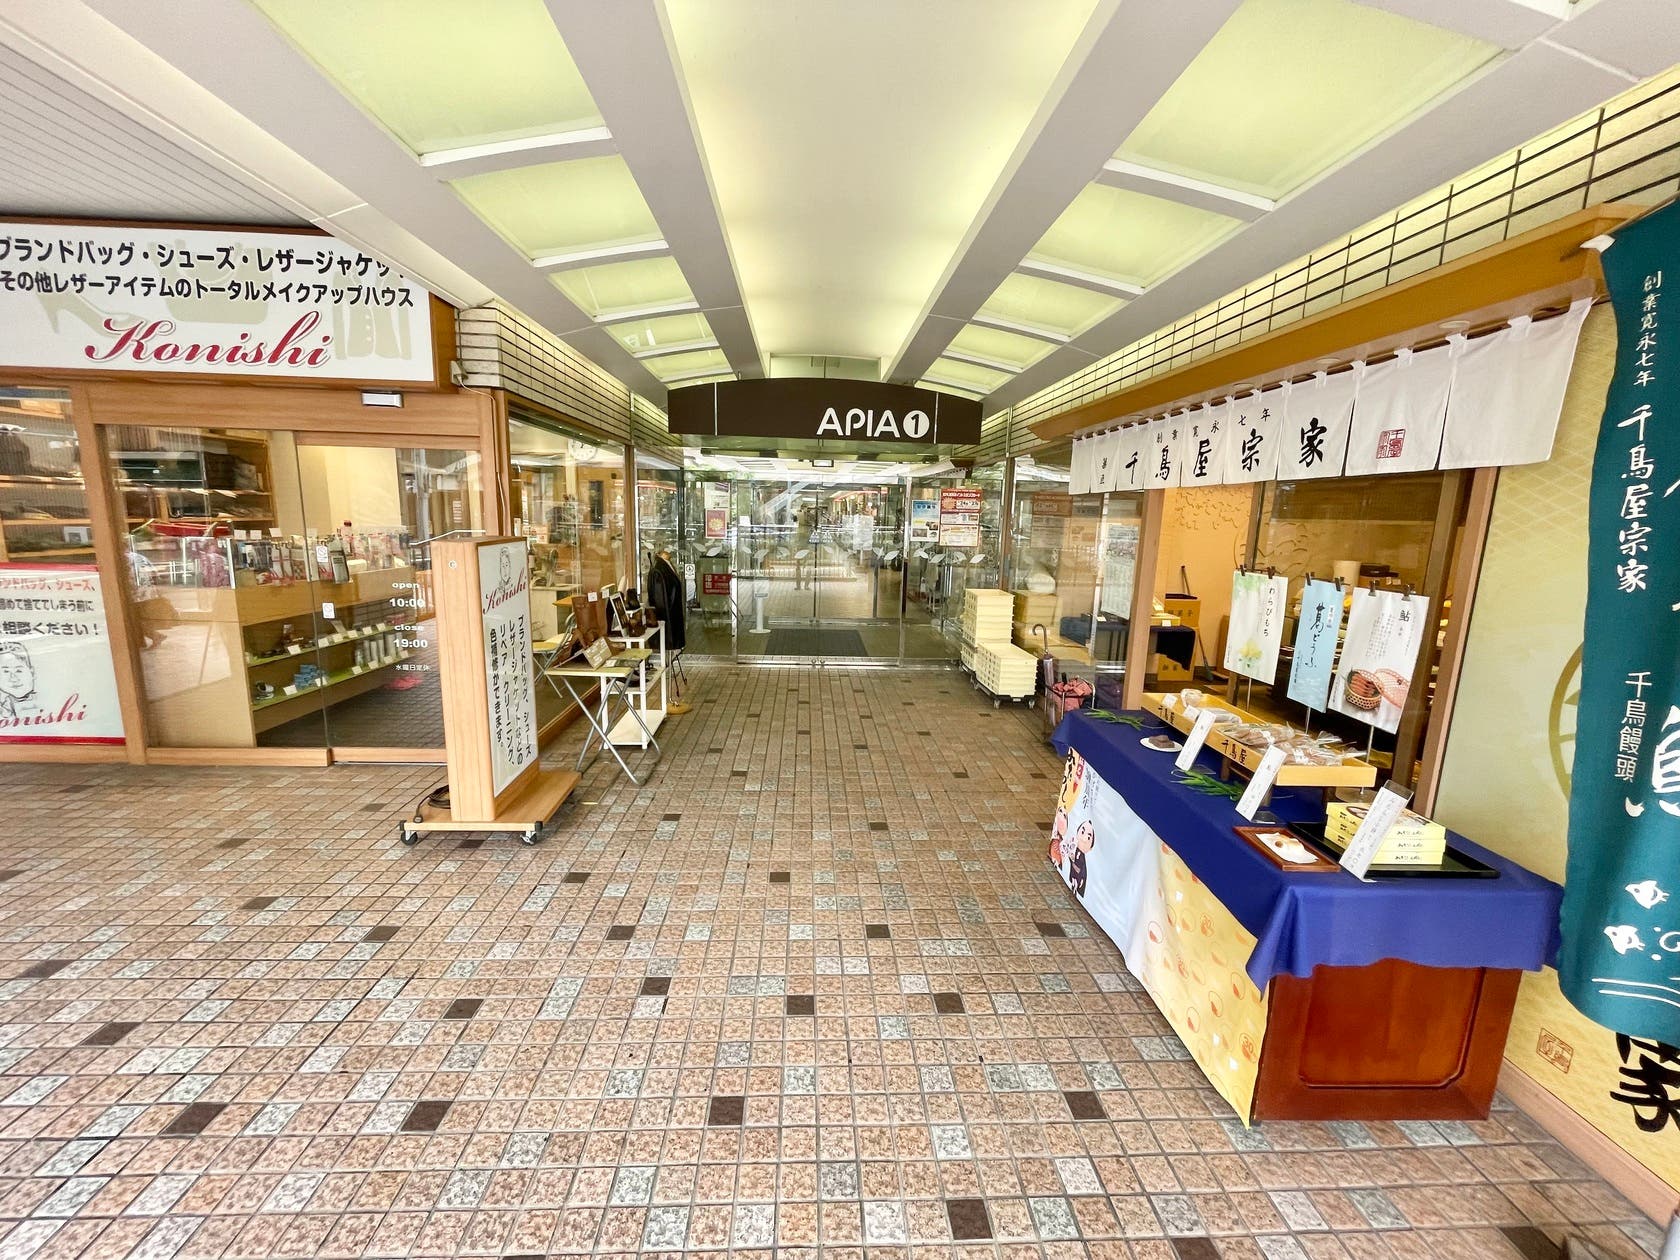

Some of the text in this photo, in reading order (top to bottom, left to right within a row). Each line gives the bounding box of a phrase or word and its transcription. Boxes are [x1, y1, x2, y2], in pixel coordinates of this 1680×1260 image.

[0, 236, 405, 279] ブランドバッグ・シューズ・レザージャケッ
[0, 270, 414, 308] その他レザーアイテムのトータルメイクアップハウス
[85, 310, 331, 366] Konishi
[816, 407, 900, 438] APIA
[1616, 270, 1662, 593] 創業寛永七年 千鳥屋宗家
[1125, 417, 1328, 485] 千鳥屋宗家
[389, 598, 426, 608] 10:00
[392, 582, 419, 590] open
[0, 620, 99, 636] 相談ください！
[393, 638, 429, 648] 19:00
[394, 623, 425, 631] close
[0, 693, 87, 729] onishi
[1614, 671, 1653, 784] 千鳥饅頭
